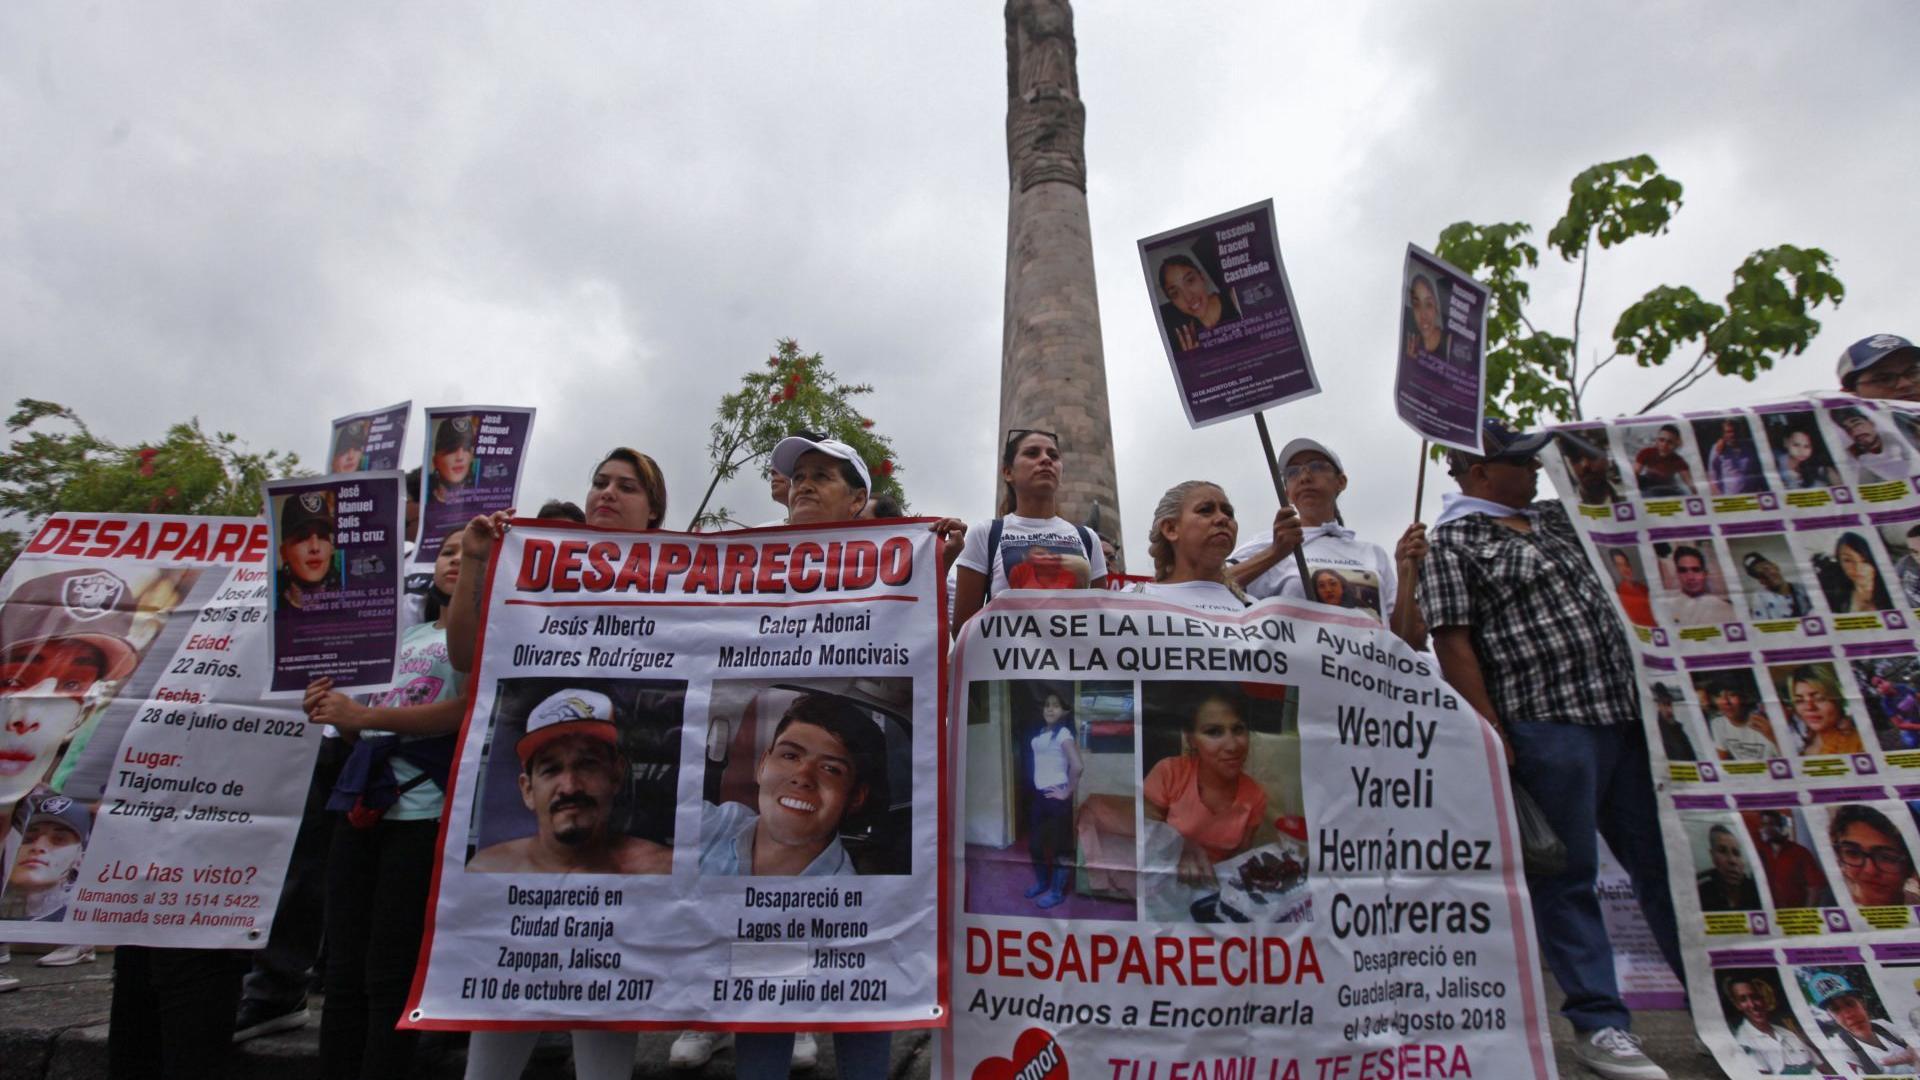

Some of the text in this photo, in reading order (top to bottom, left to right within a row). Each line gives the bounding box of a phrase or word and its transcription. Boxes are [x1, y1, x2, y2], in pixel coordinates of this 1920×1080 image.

[338, 485, 360, 498] José
[338, 500, 373, 514] Manuel
[337, 530, 384, 544] de la cruz
[515, 535, 915, 595] DESAPARECIDO
[539, 614, 656, 636] Jesús Alberto
[758, 609, 871, 639] Calep Adonai
[980, 613, 1297, 644] VIVA SE LA LLEVARON
[186, 634, 235, 651] Edad:
[718, 642, 909, 669] Maldonado Moncivais
[1316, 627, 1431, 677] Ayudanos
[170, 657, 243, 678] 22 años.
[512, 644, 675, 672] Olivares Rodríguez
[993, 647, 1288, 675] VIVA LA QUEREMOS
[1321, 654, 1459, 711] Encontrarla
[141, 707, 305, 738] 28 de julio del 2022
[1338, 705, 1438, 760] Wendy
[124, 747, 183, 770] Lugar:
[119, 770, 244, 797] Tlajomulco de
[1351, 766, 1433, 809] Yareli
[184, 806, 254, 824] Jalisco.
[1318, 828, 1492, 873] Hernández
[98, 860, 258, 885] ¿Lo has visto?
[77, 887, 139, 904] llamanos
[143, 893, 155, 905] al
[158, 894, 178, 906] 33
[184, 894, 219, 907] 1514
[508, 884, 623, 909] Desapareció en
[744, 886, 863, 910] Desapareció en
[72, 907, 87, 921] tu
[91, 908, 149, 924] llamada
[153, 913, 185, 926] sera
[510, 915, 614, 942] Ciudad Granja
[1331, 893, 1491, 939] Contreras
[737, 917, 868, 942] Lagos de Moreno
[498, 946, 621, 974] Zapopan, Jalisco
[812, 947, 866, 969] Jalisco
[965, 927, 1325, 987] DESAPARECIDA
[1453, 950, 1477, 967] en
[461, 978, 654, 1002] El 10 de octubre del 2017
[713, 979, 888, 1005] El 26 de julio del 2021
[1436, 977, 1506, 999] Jalisco
[968, 988, 1314, 1028] Ayudanos a Encontrarla
[1344, 1015, 1359, 1042] el
[1461, 1008, 1506, 1030] 2018
